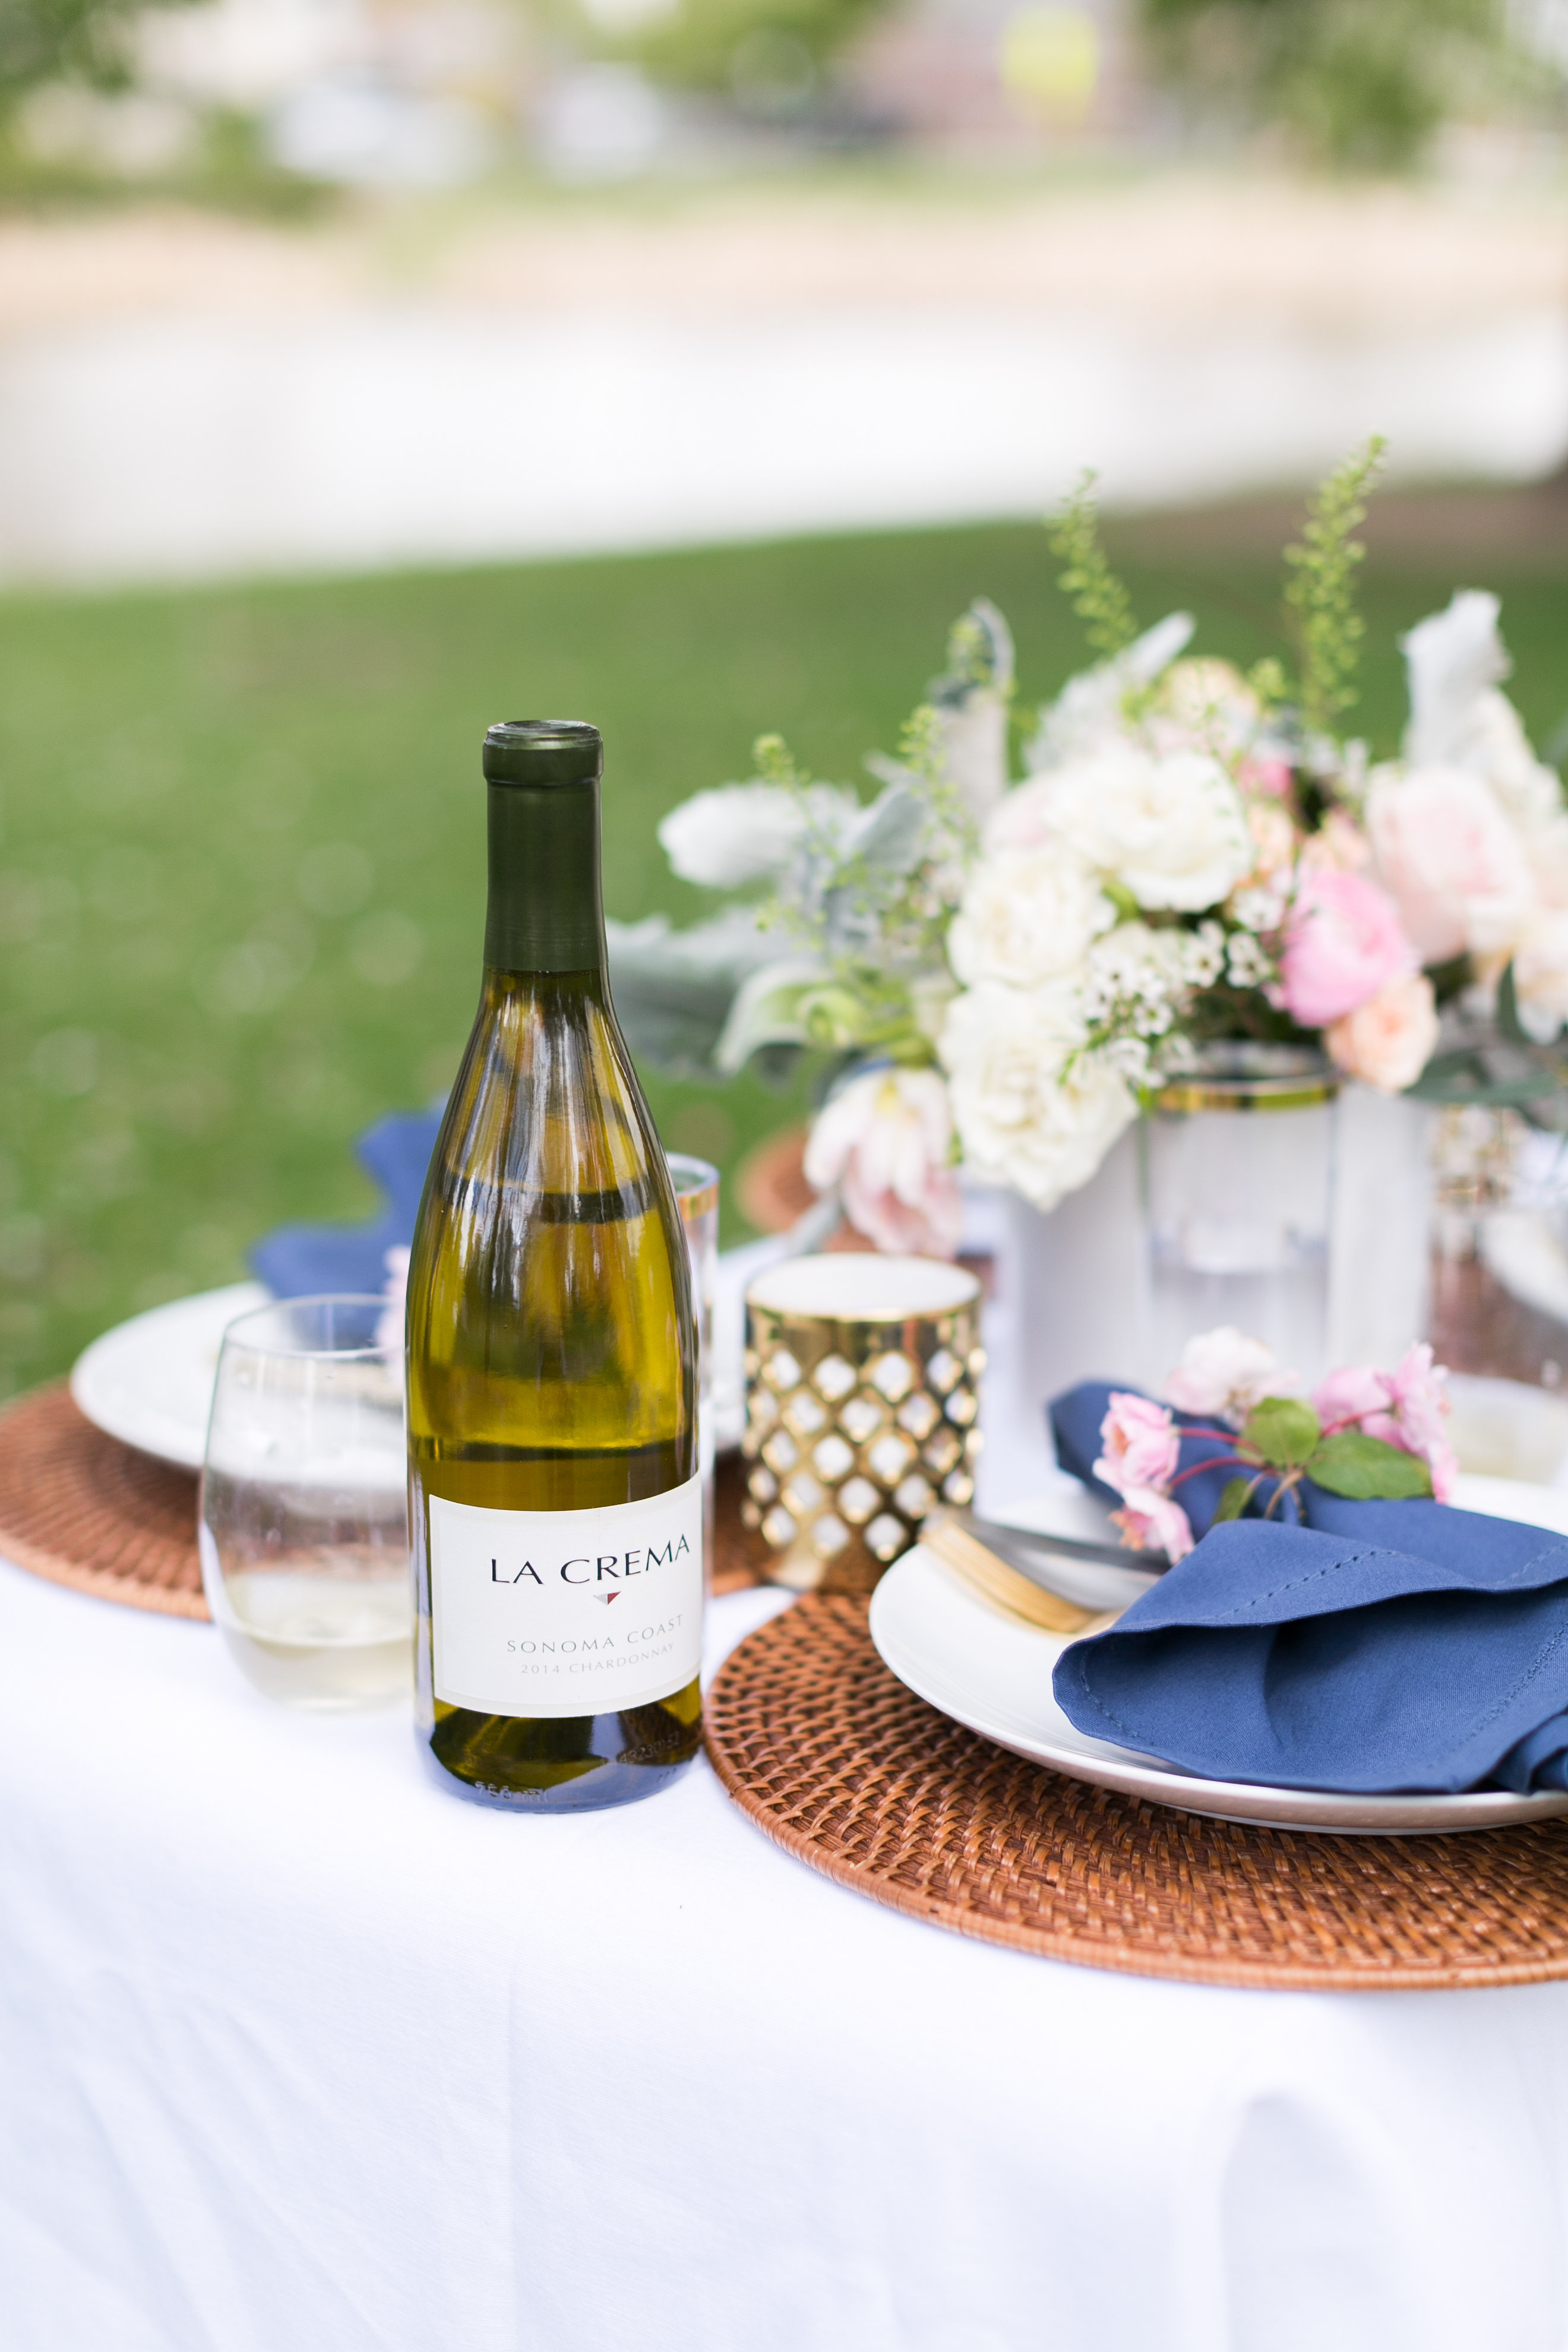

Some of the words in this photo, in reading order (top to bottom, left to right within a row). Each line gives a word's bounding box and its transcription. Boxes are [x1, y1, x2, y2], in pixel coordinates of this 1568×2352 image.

[491, 1558, 543, 1585] LA
[560, 1533, 690, 1584] CREMA
[507, 1636, 615, 1654] SONOMA
[627, 1613, 684, 1644] COAST
[520, 1664, 561, 1674] 2014
[569, 1642, 675, 1674] CHARDONNAY
[475, 1781, 512, 1800] 750
